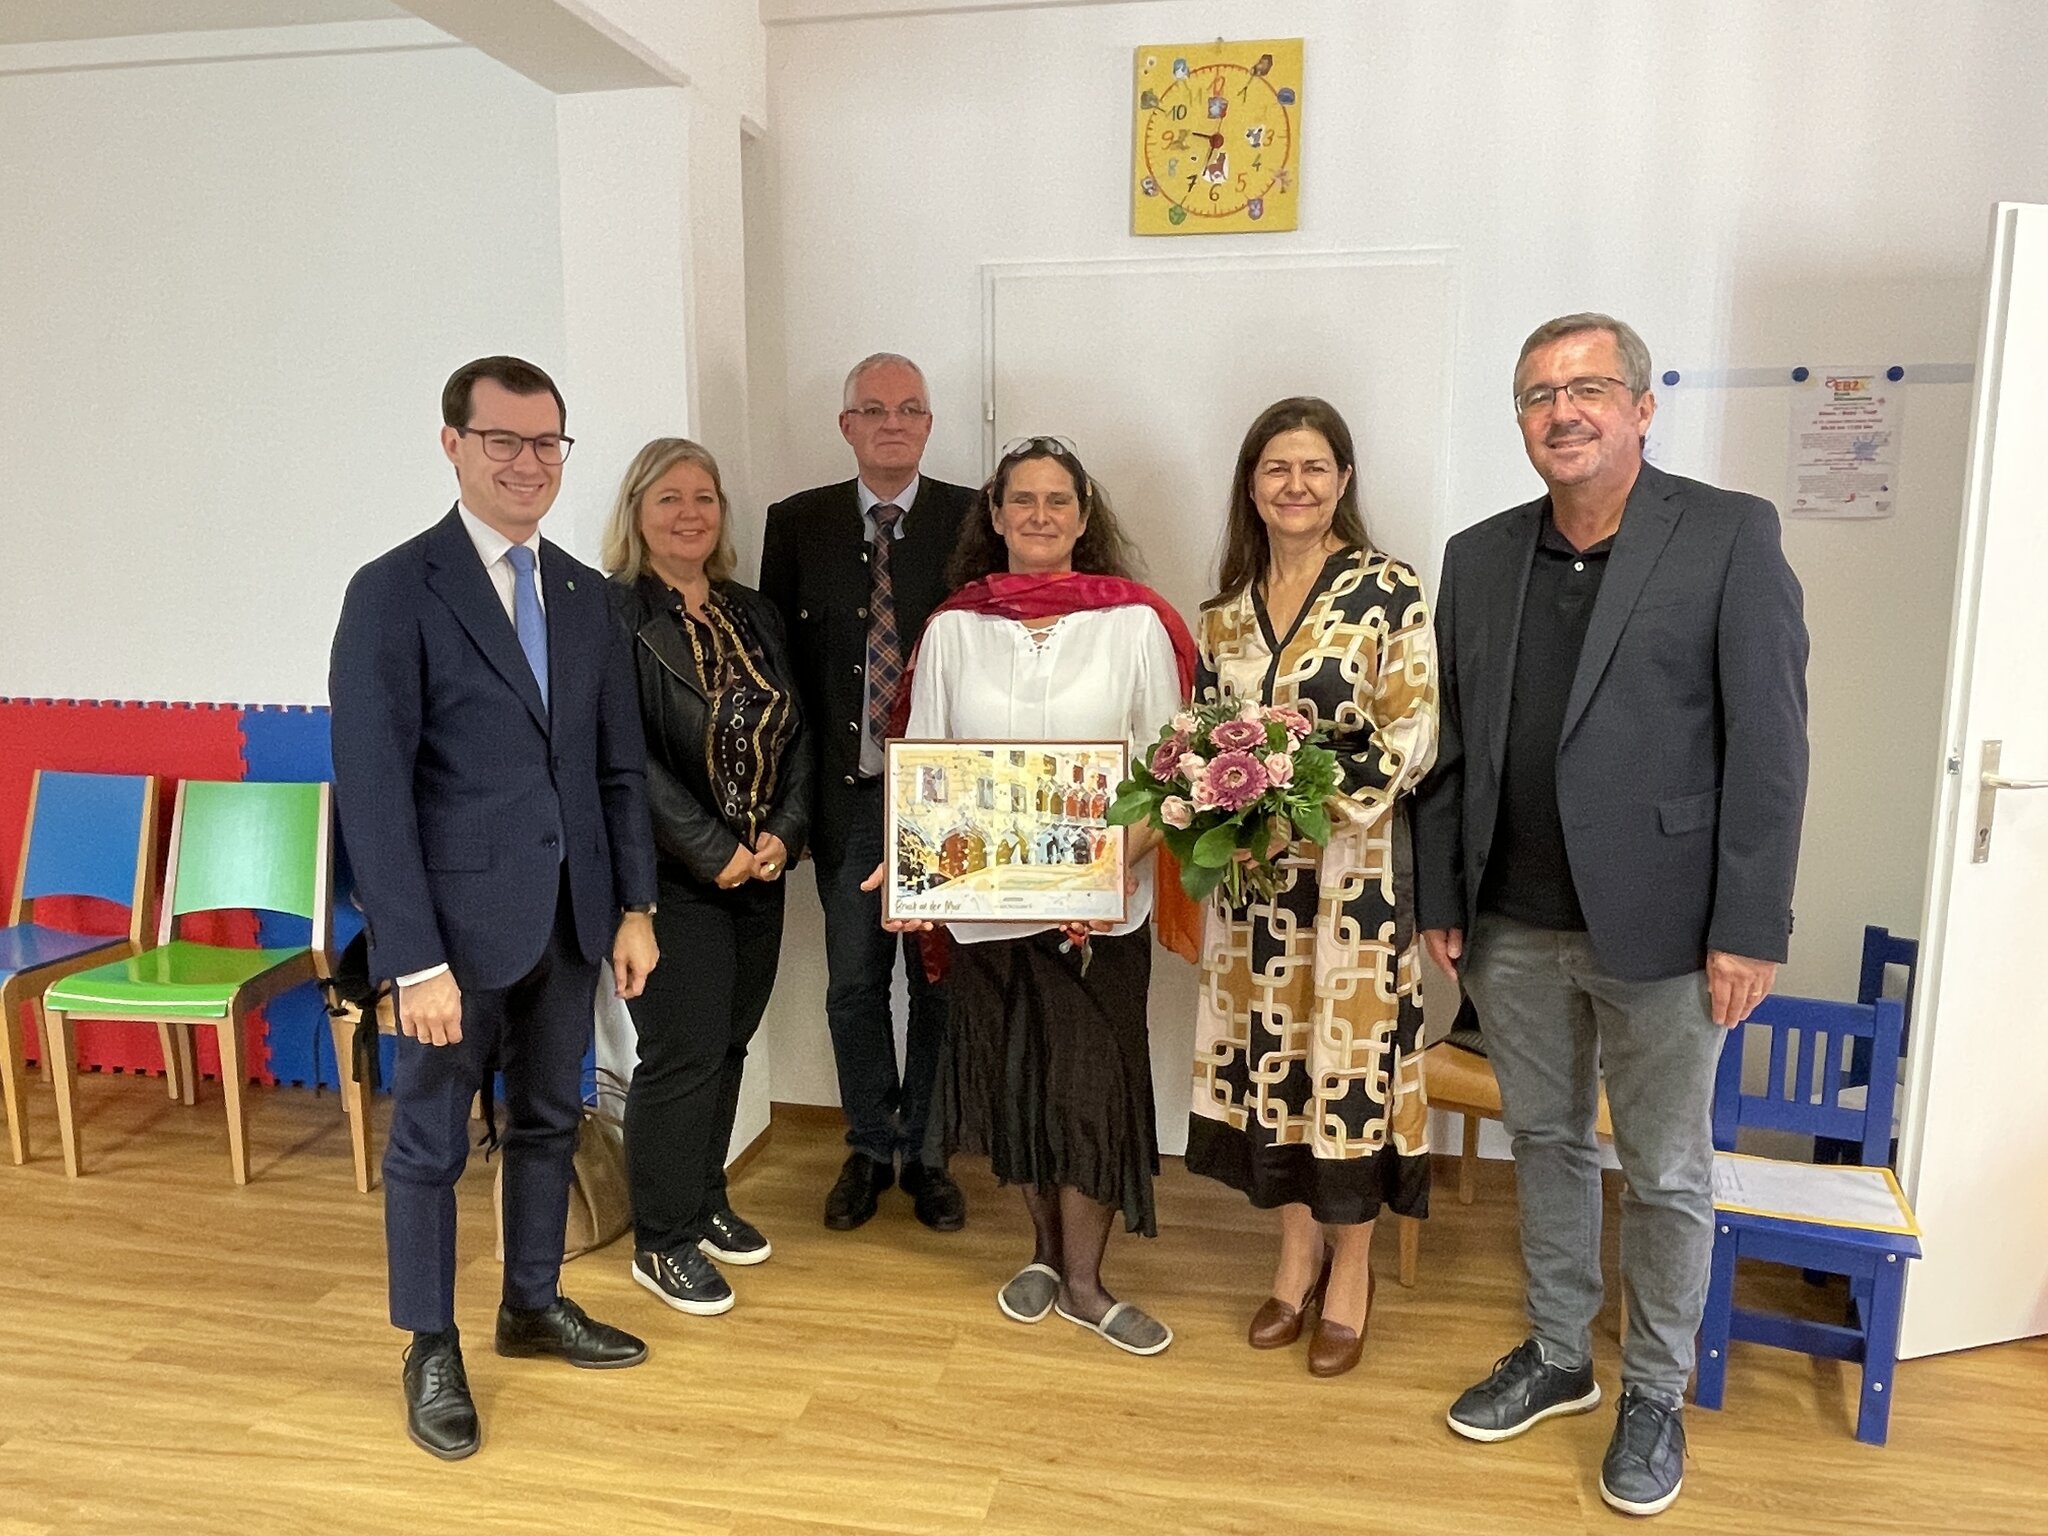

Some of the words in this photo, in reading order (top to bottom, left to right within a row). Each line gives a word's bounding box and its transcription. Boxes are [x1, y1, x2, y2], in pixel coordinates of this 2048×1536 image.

[1237, 86, 1248, 104] 1
[1166, 104, 1188, 121] 10
[1161, 130, 1175, 151] 9
[1263, 130, 1275, 147] 3
[1252, 154, 1261, 172] 4
[1187, 175, 1197, 192] 7
[1235, 172, 1246, 192] 5
[1209, 184, 1220, 201] 6
